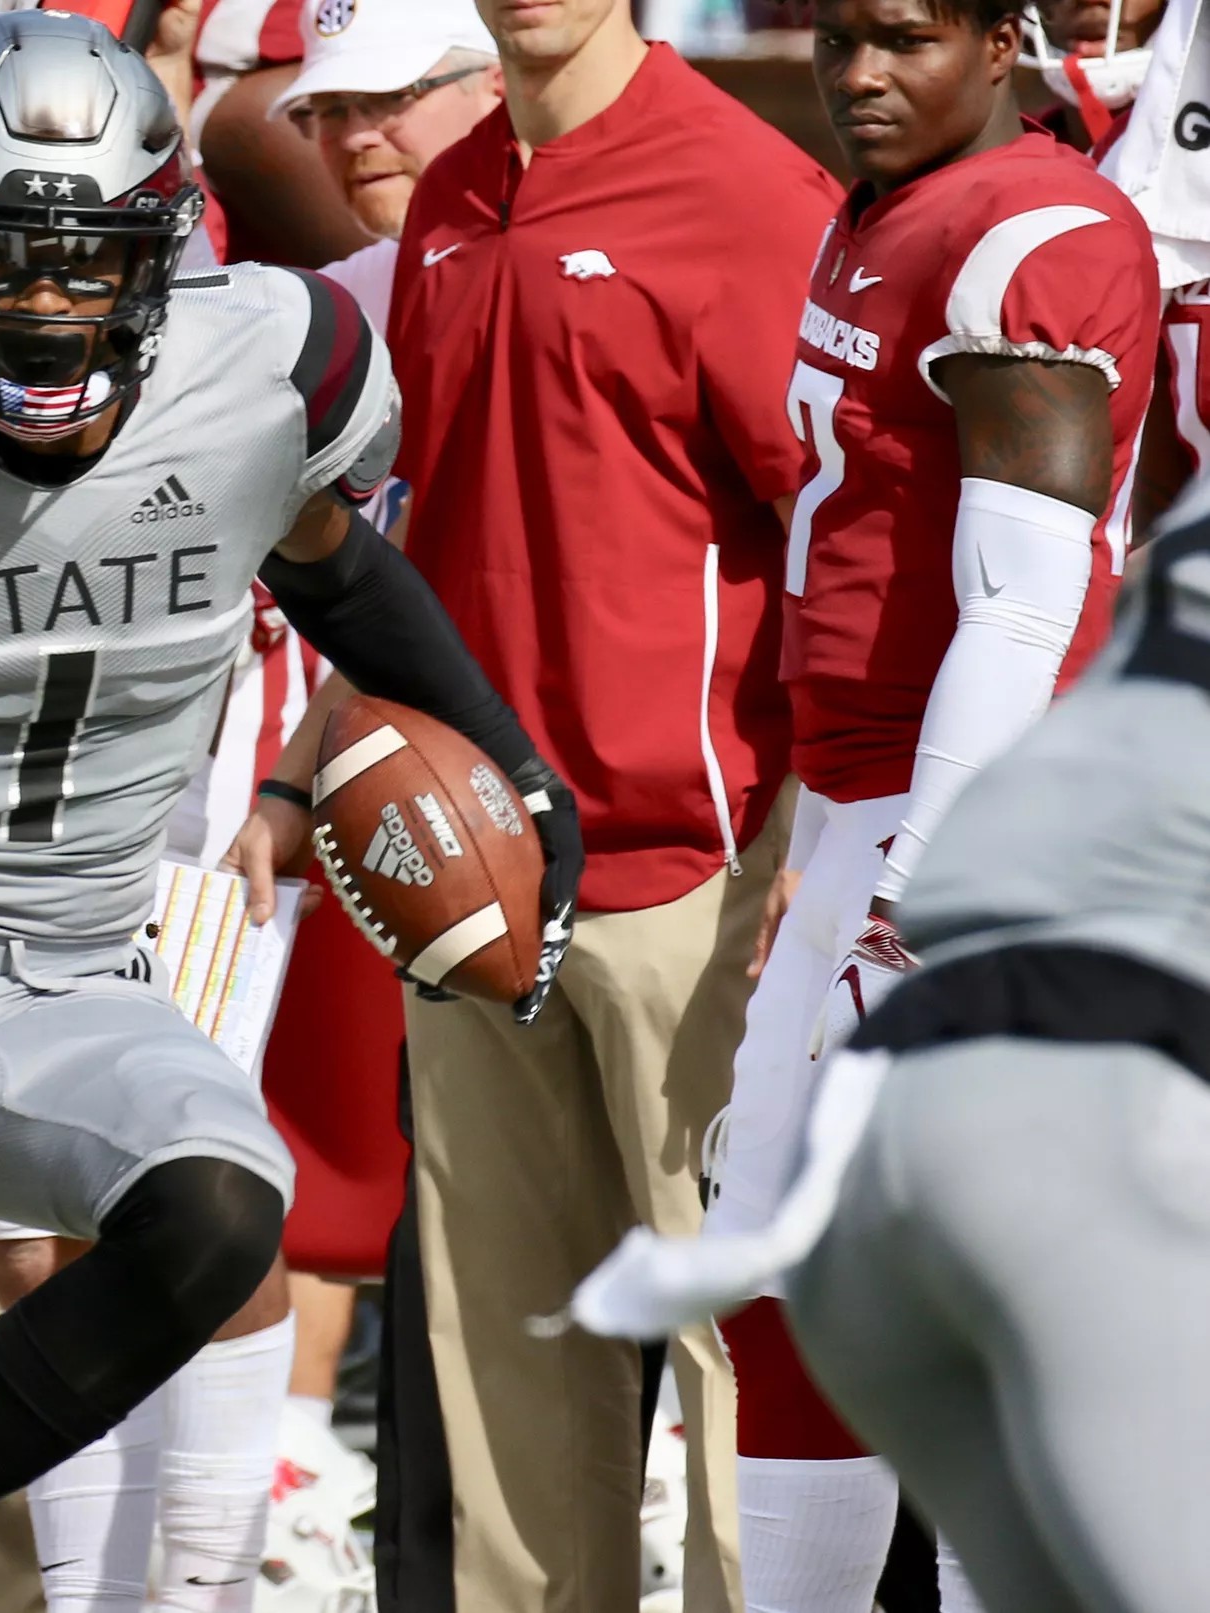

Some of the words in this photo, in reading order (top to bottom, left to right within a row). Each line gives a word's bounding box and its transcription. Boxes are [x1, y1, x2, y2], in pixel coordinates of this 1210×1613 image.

[130, 502, 205, 524] adidas
[786, 359, 845, 597] 7
[2, 646, 102, 844] 1
[380, 802, 434, 887] adidas
